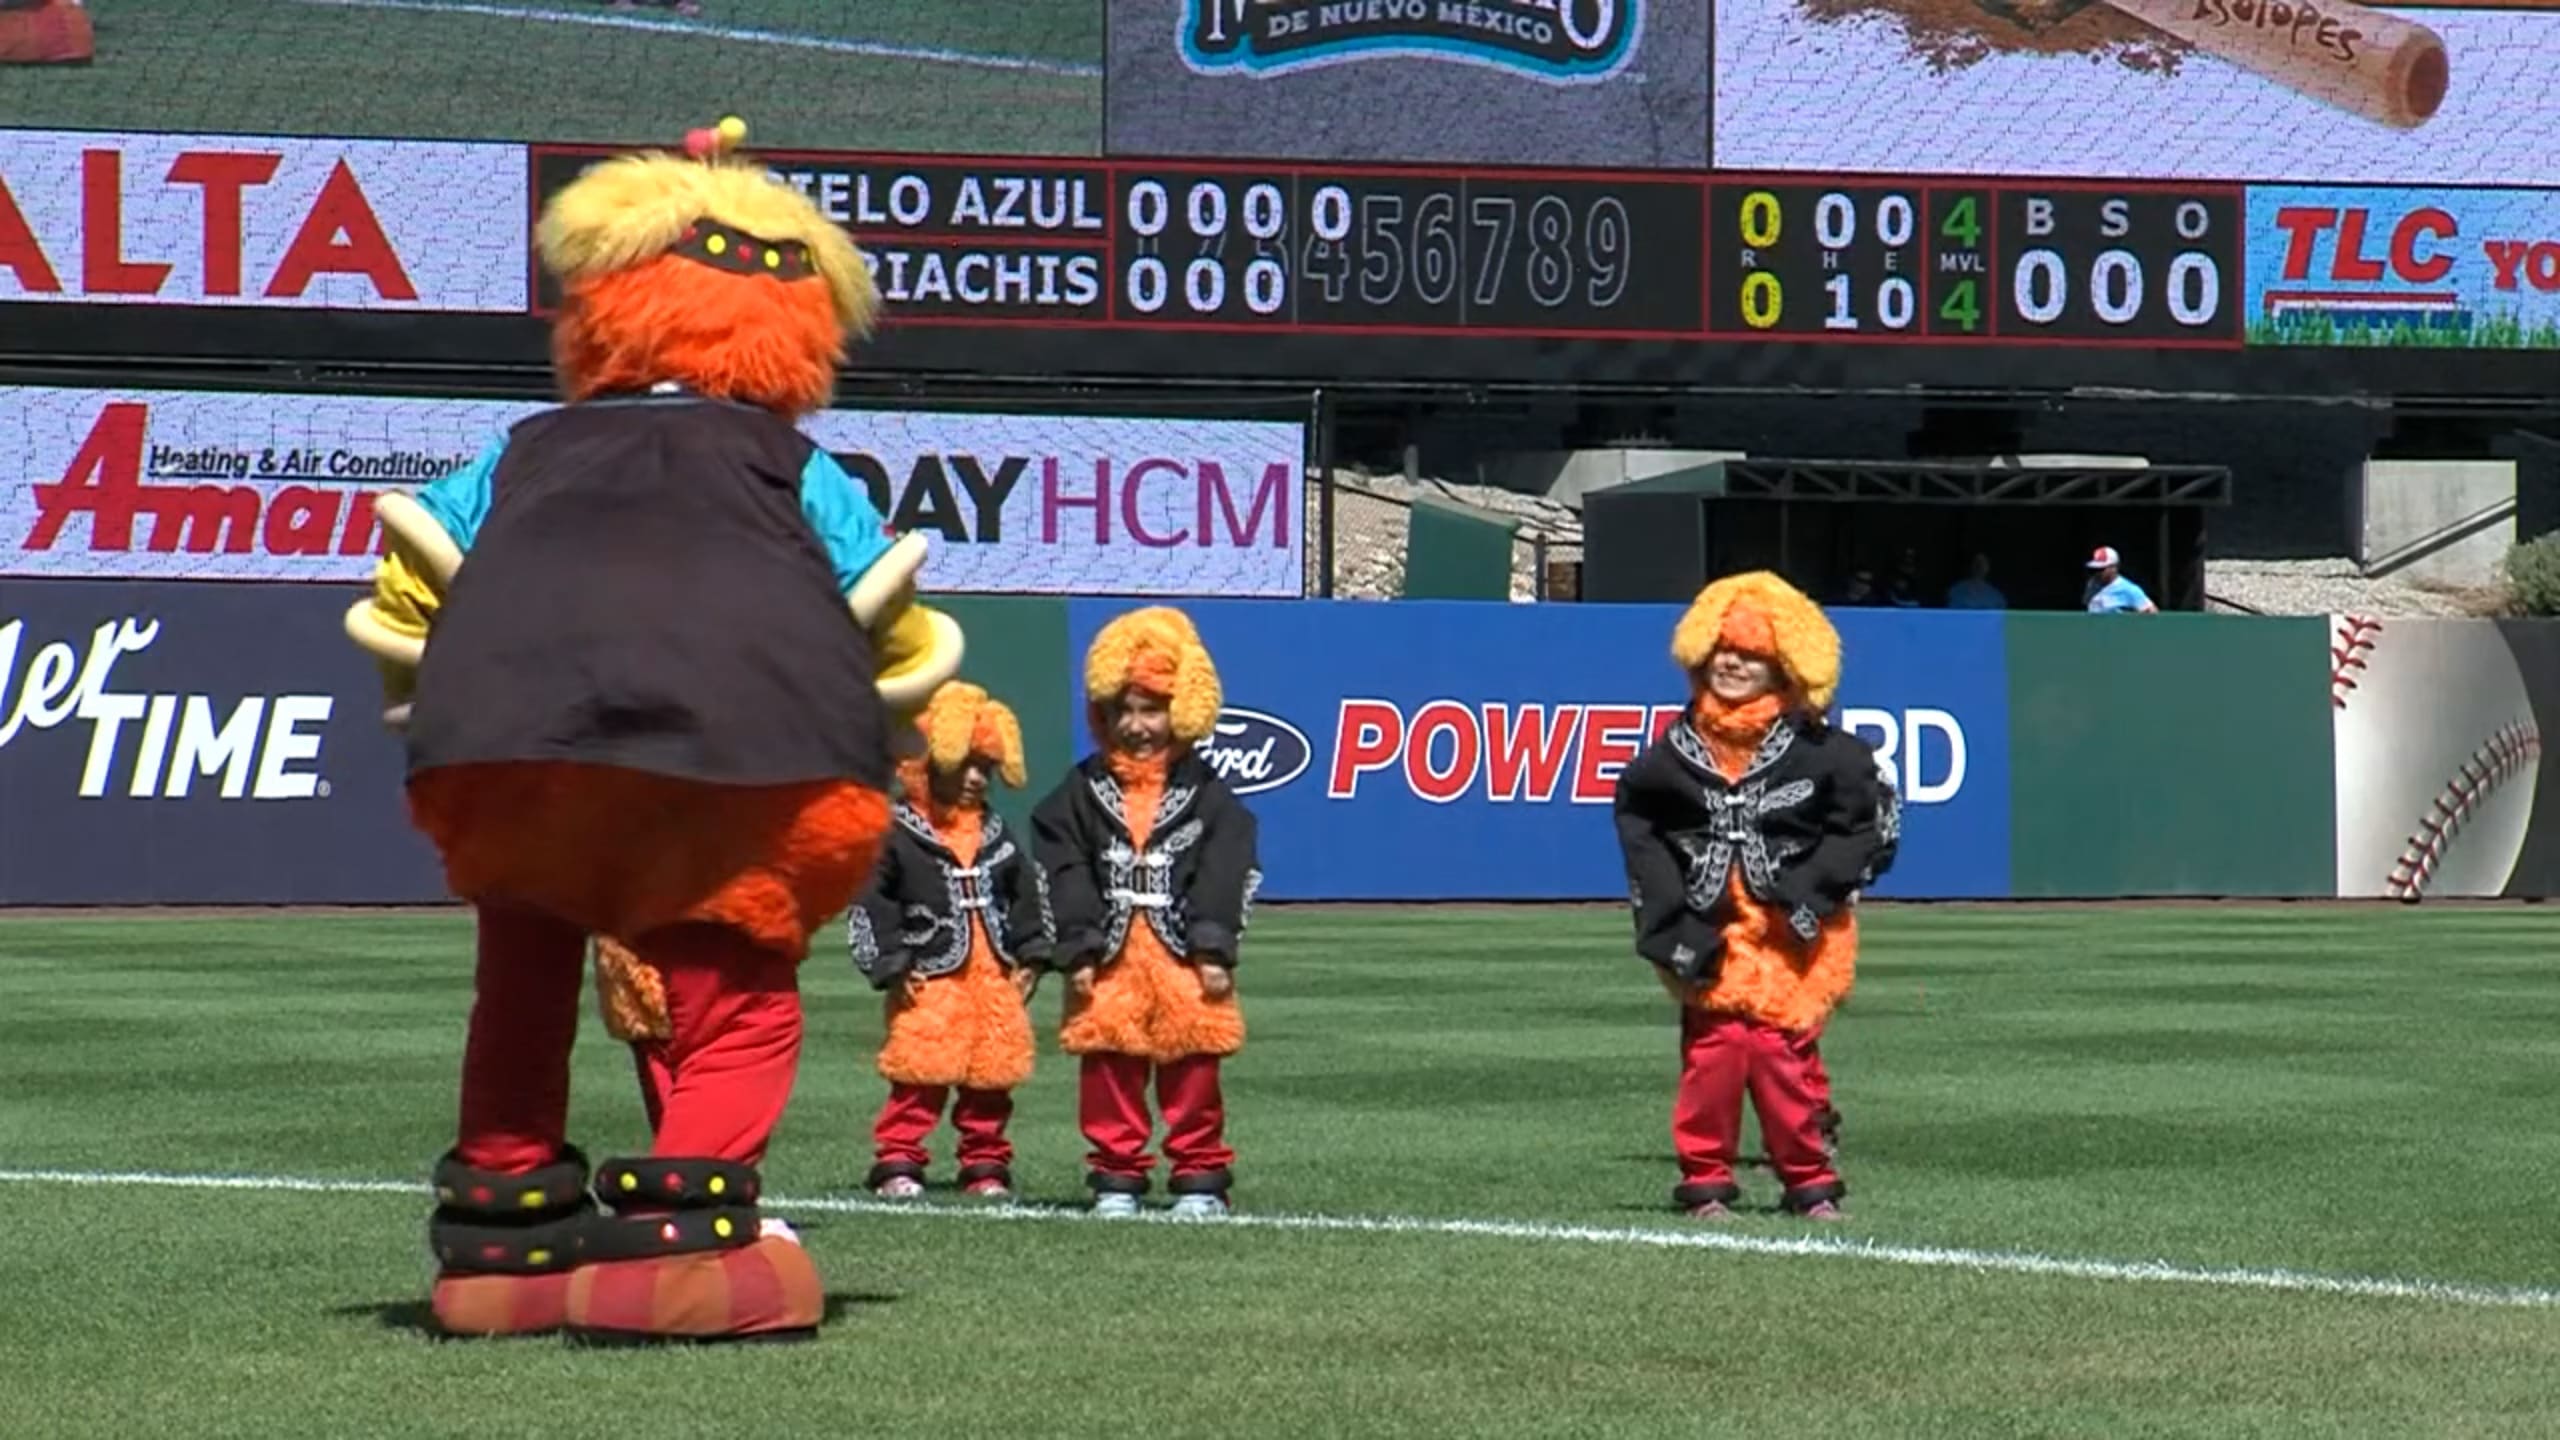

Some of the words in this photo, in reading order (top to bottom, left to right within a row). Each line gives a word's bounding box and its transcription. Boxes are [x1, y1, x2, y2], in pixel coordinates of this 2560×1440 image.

[1267, 10, 1310, 38] DE
[1319, 0, 1427, 27] NUEVO
[768, 170, 931, 226] ELO
[948, 175, 1102, 231] AZUL
[1128, 180, 1169, 236] 0
[1187, 182, 1228, 236] 0
[1243, 183, 1284, 239] 0
[1311, 185, 1352, 241] 0
[1740, 191, 1783, 248] 0
[1814, 193, 1857, 249] 0
[1876, 195, 1914, 247] 0
[1941, 196, 1982, 248] 4
[2027, 198, 2055, 235] B
[2101, 199, 2130, 237] S
[2175, 201, 2209, 239] O
[1741, 250, 1757, 267] R
[1823, 252, 1838, 269] H
[1885, 252, 1898, 270] E
[1940, 253, 1986, 272] MVL
[2276, 206, 2458, 283] TLC
[2484, 240, 2560, 293] YO
[1127, 257, 1168, 312] 0
[1185, 257, 1226, 312] 0
[1244, 258, 1285, 314] 0
[1741, 271, 1783, 329] 0
[1824, 274, 1859, 329] 1
[1877, 277, 1915, 329] 0
[1940, 279, 1981, 331] 4
[2014, 249, 2067, 324] 0
[2091, 250, 2144, 323] 0
[2167, 252, 2219, 326] 0
[149, 445, 249, 480] Heating
[258, 449, 276, 474] &
[282, 449, 322, 474] Air
[328, 450, 475, 478] Conditioni
[1041, 456, 1289, 548] HCM
[76, 694, 333, 798] TIME
[1329, 698, 1686, 804] POWE
